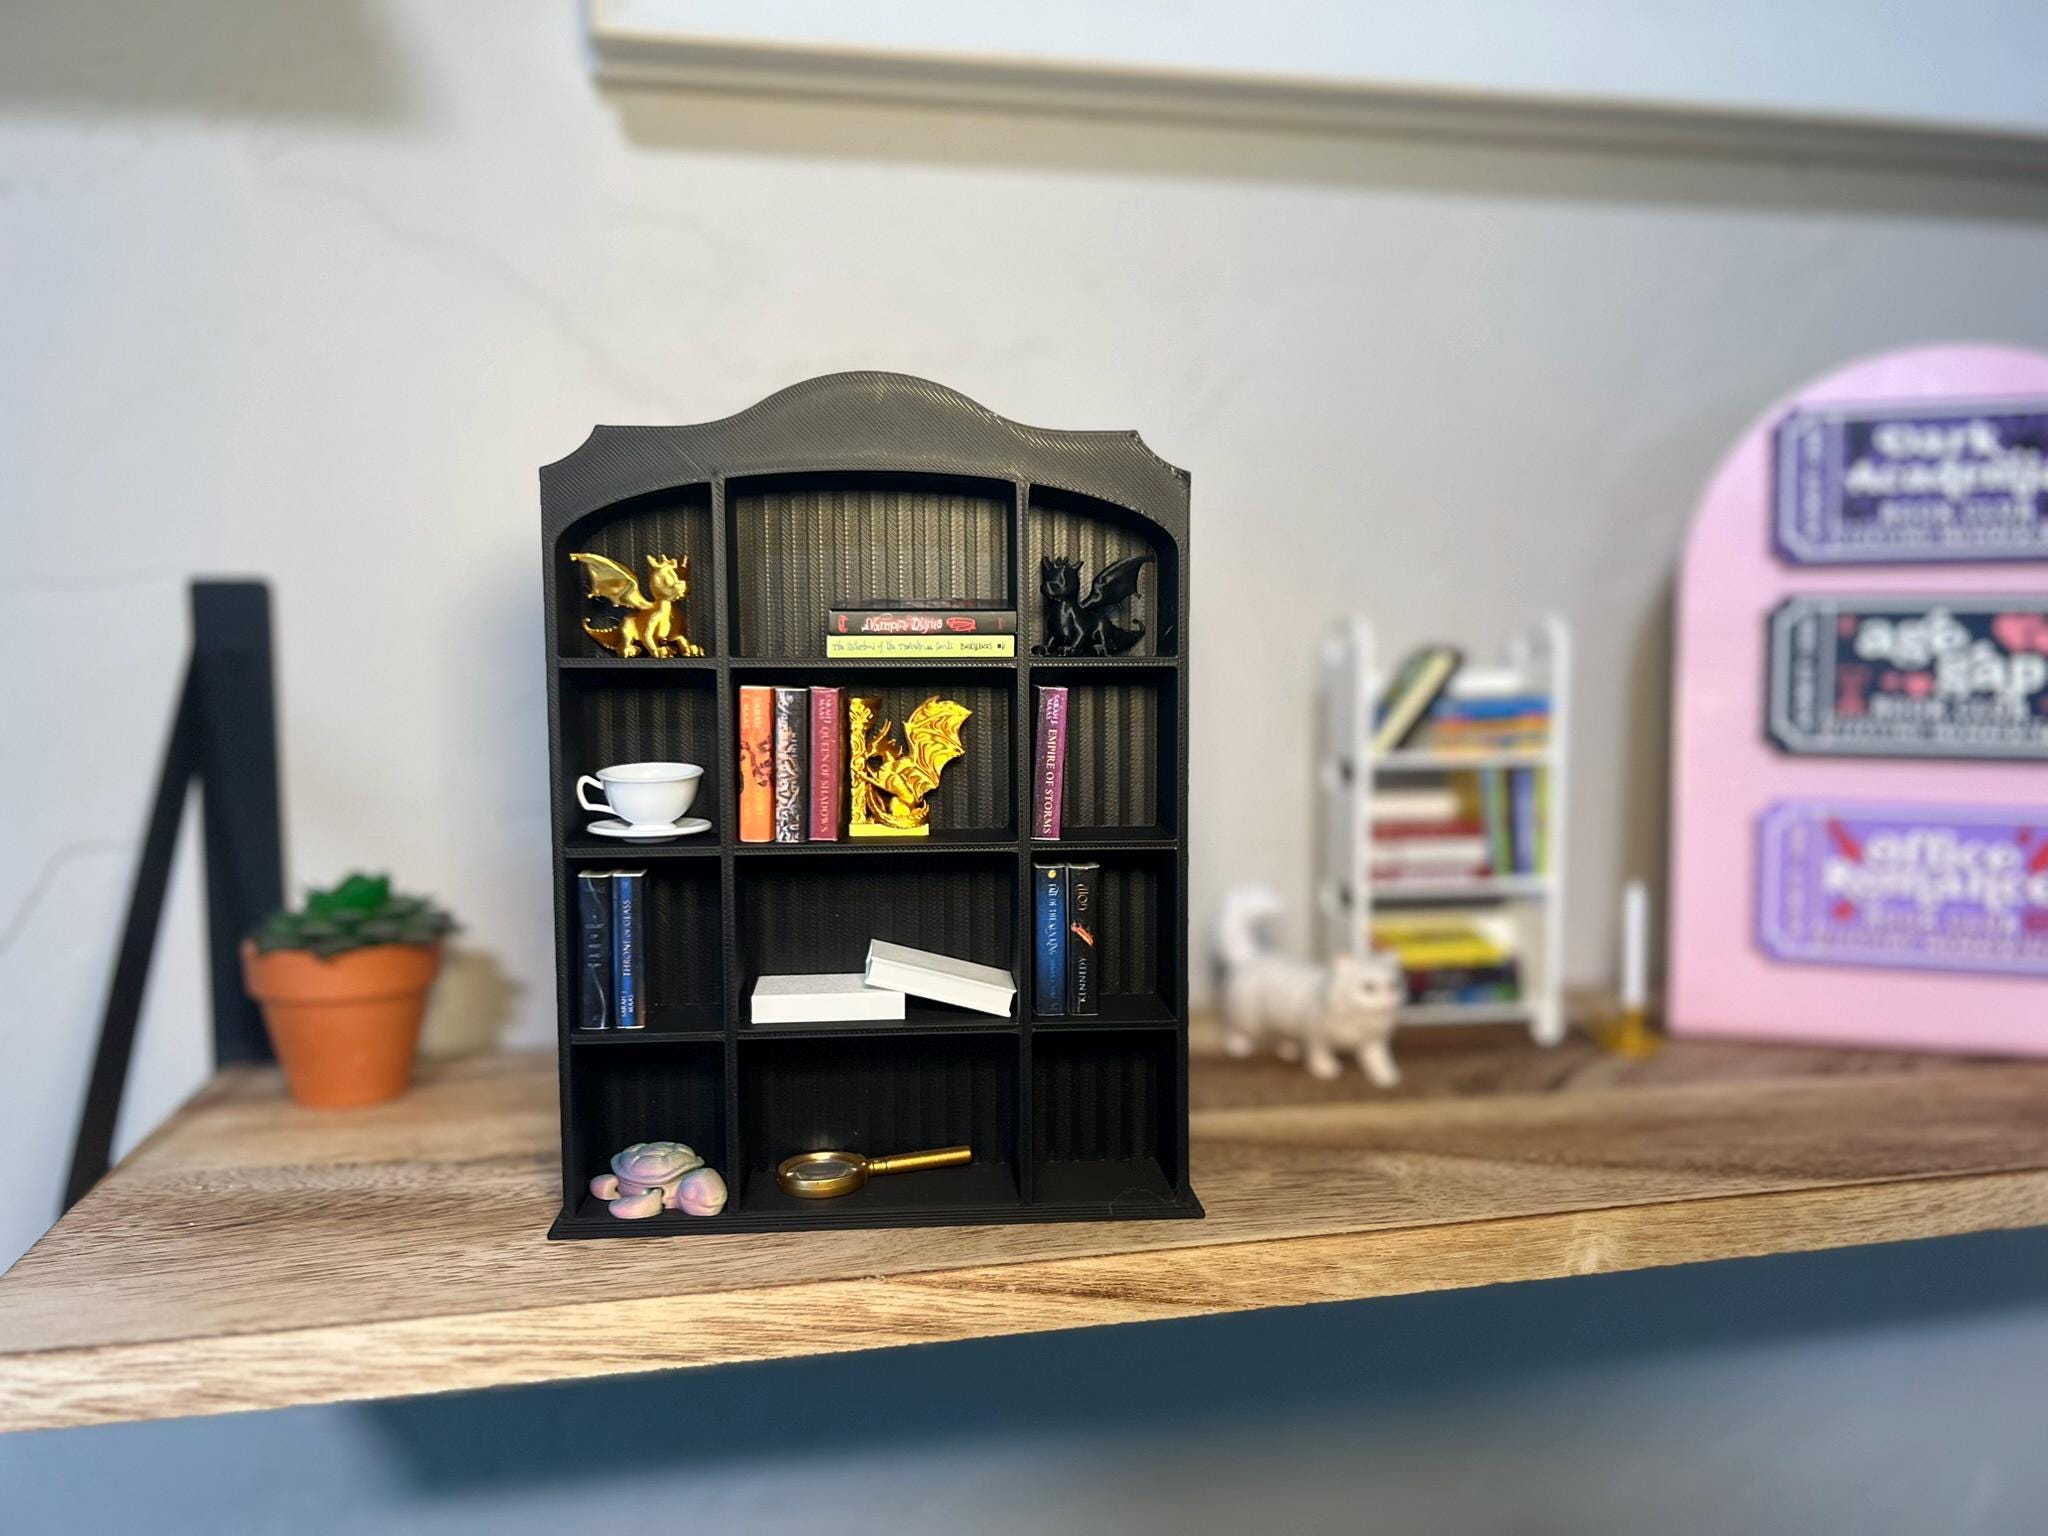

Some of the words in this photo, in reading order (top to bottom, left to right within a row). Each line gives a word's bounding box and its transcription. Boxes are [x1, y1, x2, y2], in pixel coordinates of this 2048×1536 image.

[819, 726, 829, 762] QUEEN
[1046, 729, 1058, 770] EMPIRE
[819, 763, 829, 777] OF
[1045, 771, 1055, 787] OF
[819, 780, 829, 833] SHADOWS
[1042, 788, 1054, 835] STORMS
[622, 899, 632, 927] GLASS
[622, 939, 632, 976] THRONE
